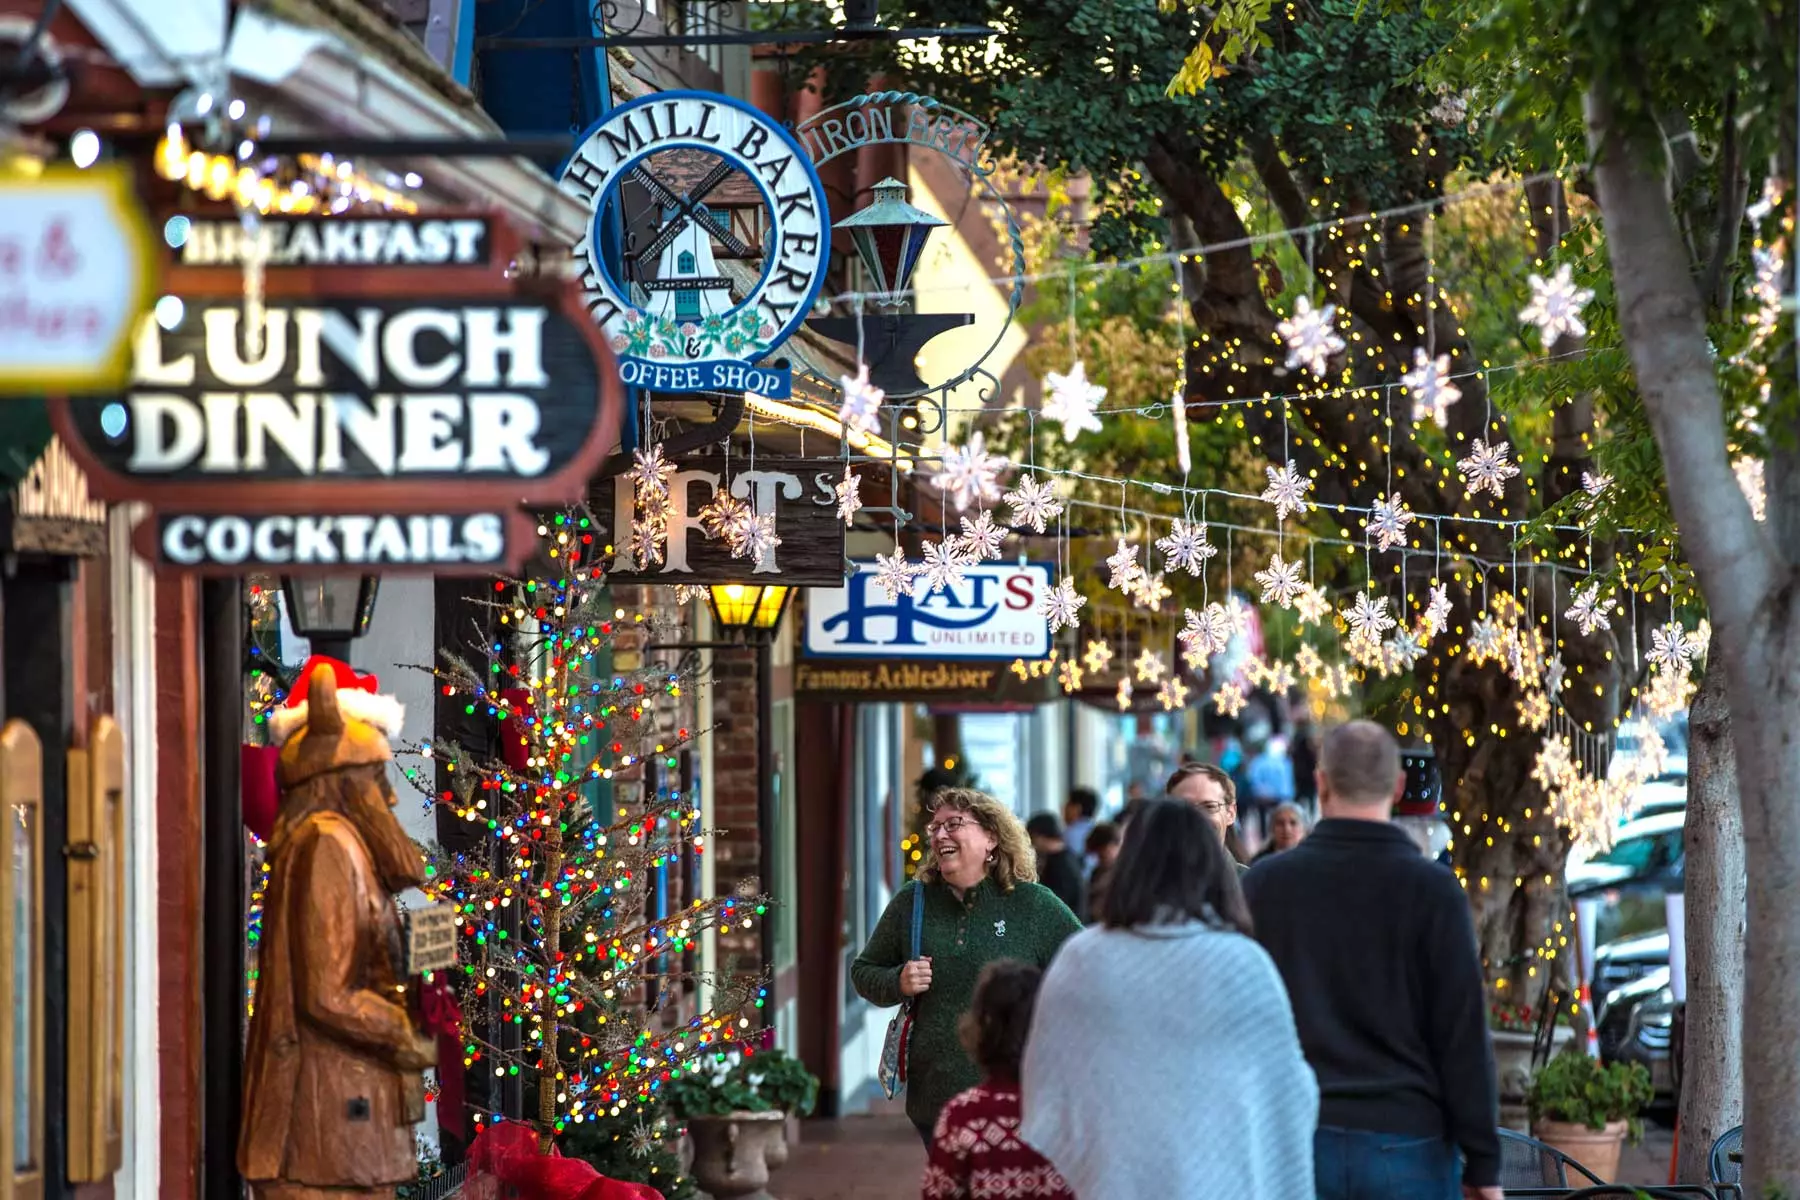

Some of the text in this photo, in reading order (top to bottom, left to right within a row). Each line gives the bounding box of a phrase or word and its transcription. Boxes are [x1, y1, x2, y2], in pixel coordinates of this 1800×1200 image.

[810, 107, 979, 160] IRON ART
[598, 102, 720, 163] MILL
[732, 120, 819, 331] BAKERY
[132, 307, 549, 388] LUNCH
[685, 337, 701, 359] &
[618, 360, 780, 395] OFFEE SHOP
[128, 391, 550, 475] DINNER
[161, 513, 503, 564] COCKTAILS
[822, 572, 1035, 645] HATS
[930, 630, 1036, 646] UNLIMITED
[797, 663, 870, 690] Famous
